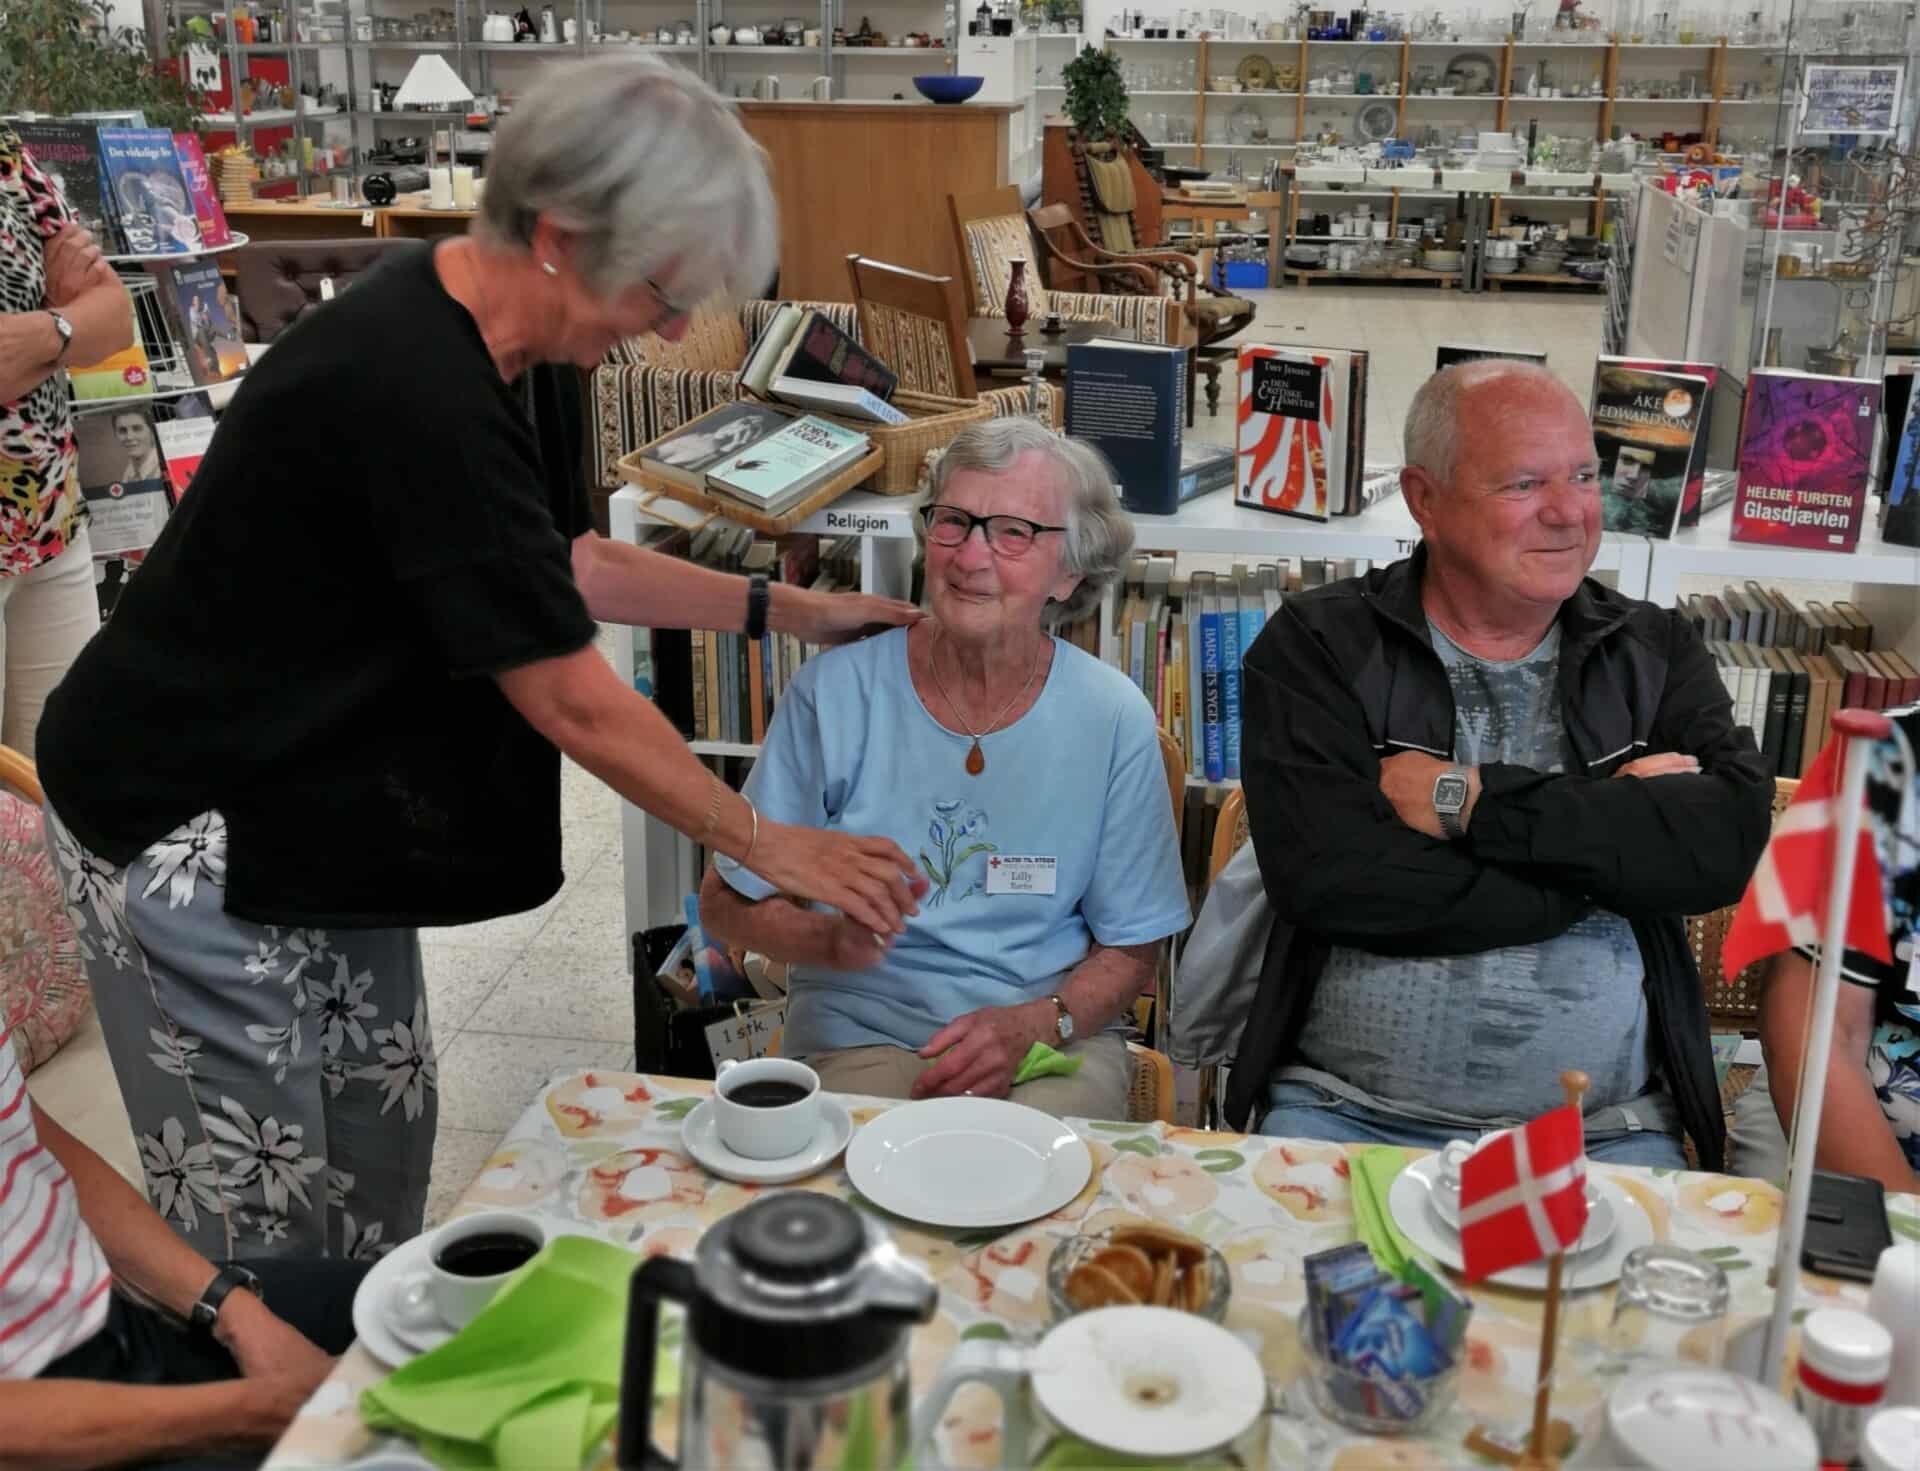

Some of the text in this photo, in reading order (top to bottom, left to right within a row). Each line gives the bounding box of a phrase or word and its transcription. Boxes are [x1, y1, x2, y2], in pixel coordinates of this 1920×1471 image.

[1599, 404, 1693, 432] EDWARDSON
[1746, 485, 1853, 508] HELENE TURSTEN
[826, 513, 889, 532] Religion
[1743, 501, 1850, 529] Glasdjævlen
[1225, 674, 1237, 700] OM
[1206, 688, 1220, 764] SYGDOMME
[1226, 704, 1240, 762] BARNET
[1011, 871, 1032, 882] Lilly
